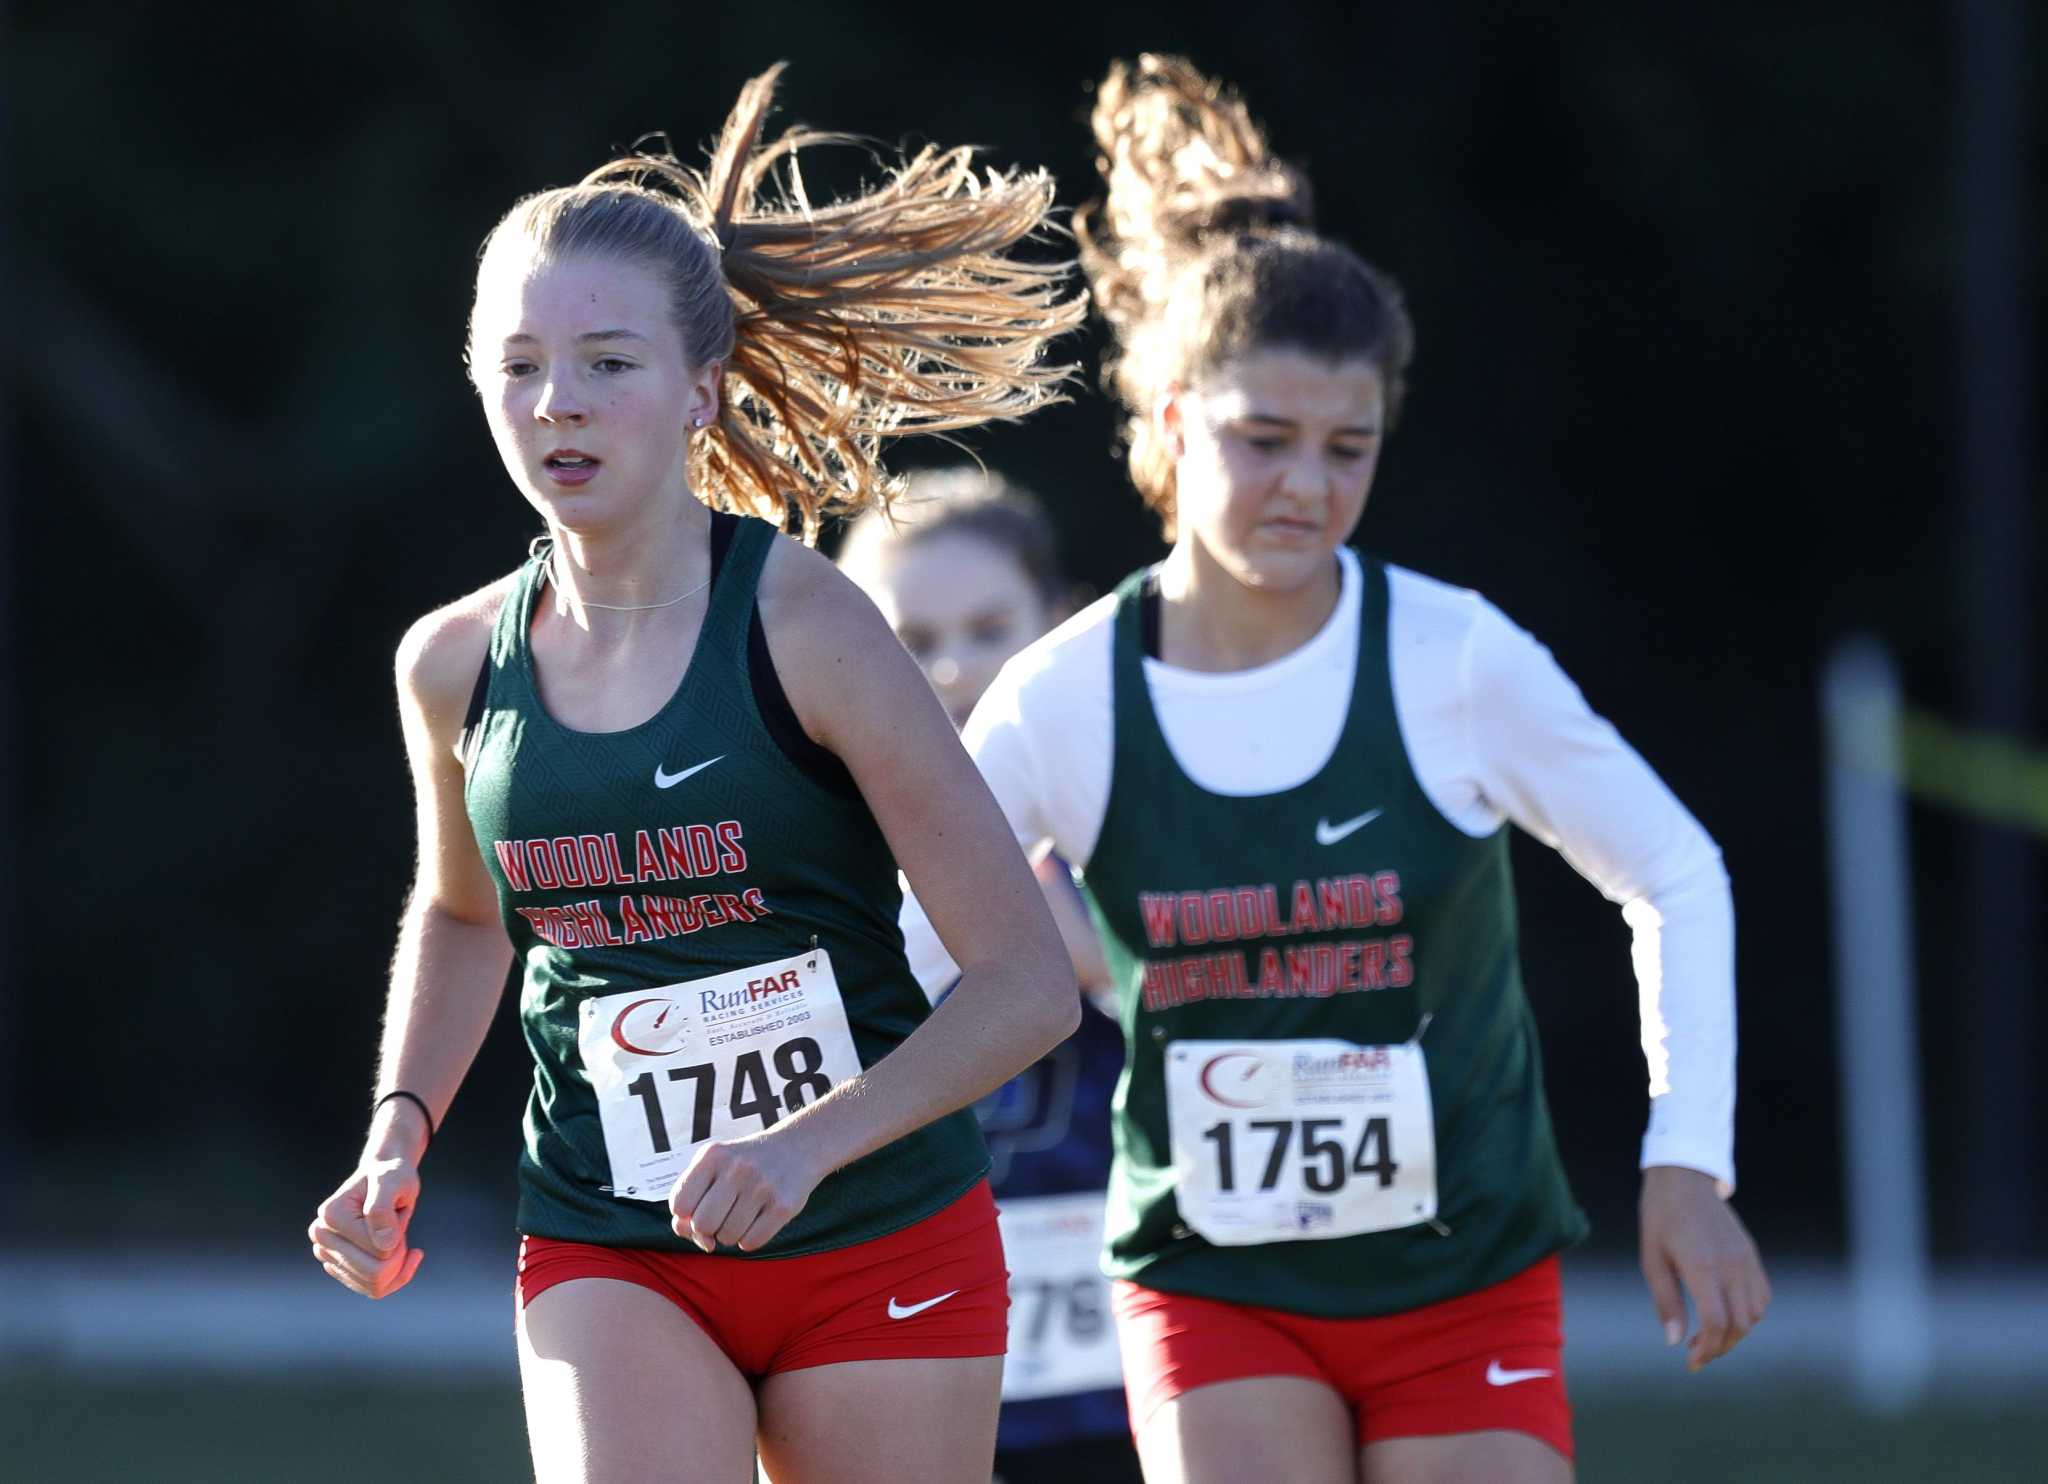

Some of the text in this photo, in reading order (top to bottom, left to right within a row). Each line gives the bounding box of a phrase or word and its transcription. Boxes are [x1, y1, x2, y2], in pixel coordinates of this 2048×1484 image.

[494, 820, 748, 892] WOODLANDS
[515, 888, 773, 950] HIGHLANDERS
[1138, 870, 1403, 948] WOODLANDS
[698, 969, 801, 1015] RunFAR
[703, 990, 804, 1023] RACING SERVICES
[1140, 934, 1414, 1013] HIGHLANDERS
[709, 1019, 785, 1046] ESTABLISHED
[628, 1036, 833, 1154] 1748
[1204, 1117, 1398, 1195] 1754
